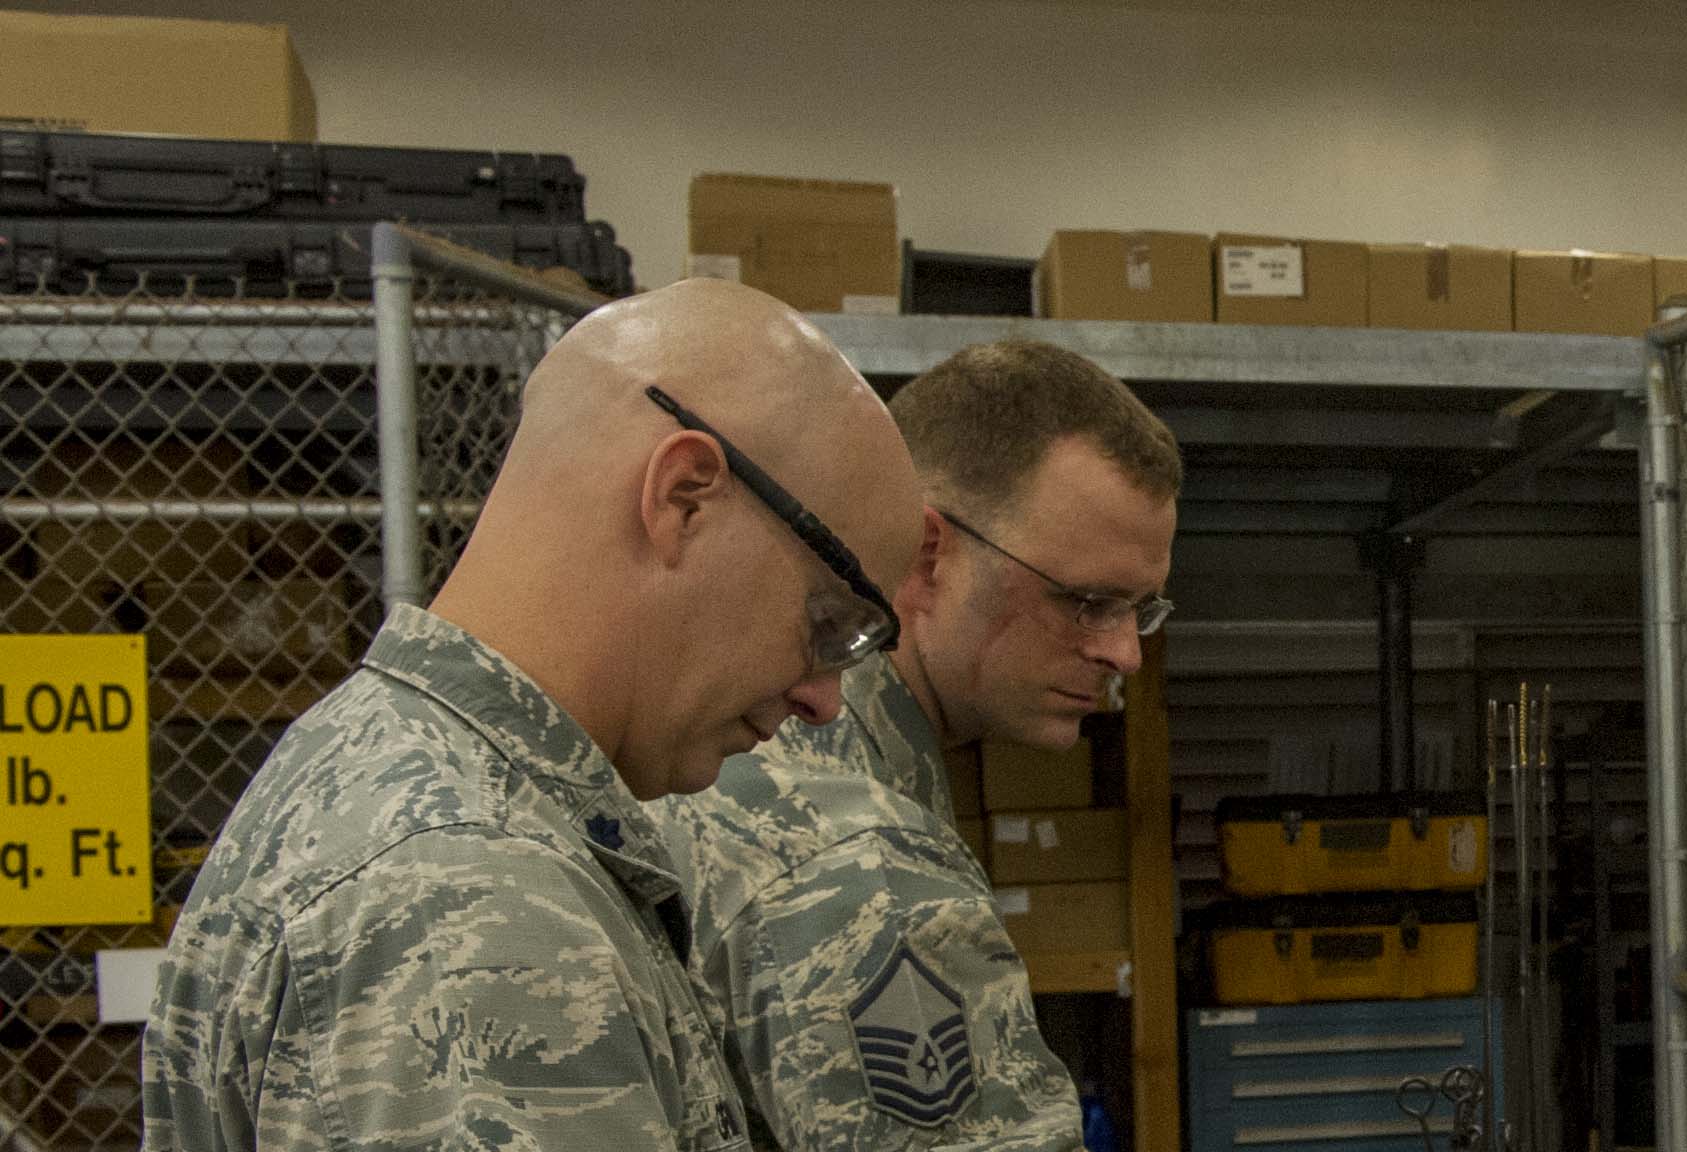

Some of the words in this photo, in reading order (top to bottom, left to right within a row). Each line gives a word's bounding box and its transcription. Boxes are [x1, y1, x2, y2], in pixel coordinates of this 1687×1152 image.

[0, 682, 133, 734] LOAD
[8, 756, 67, 806] lb.
[0, 841, 44, 890] q.
[70, 828, 137, 878] Ft.
